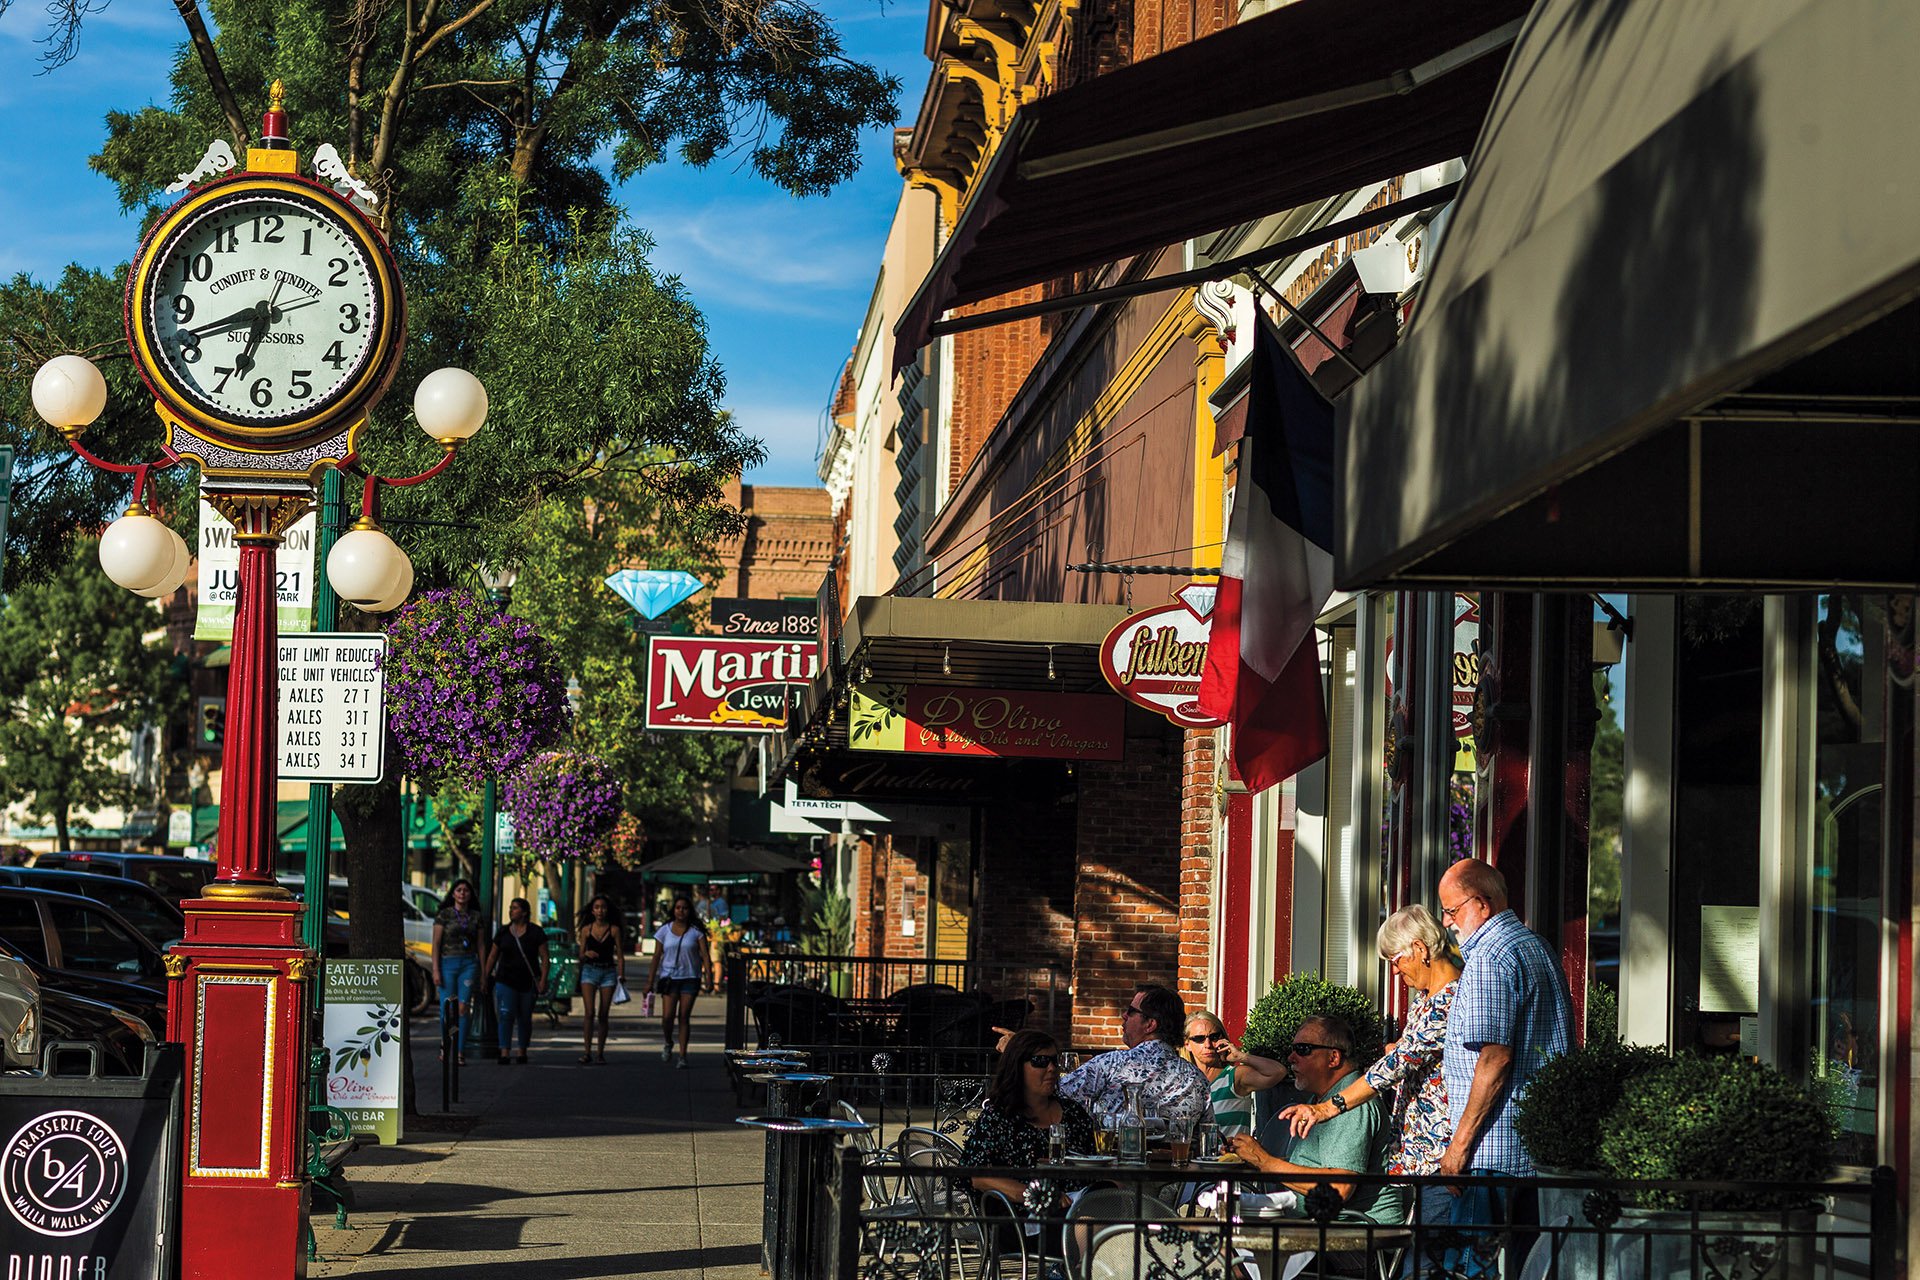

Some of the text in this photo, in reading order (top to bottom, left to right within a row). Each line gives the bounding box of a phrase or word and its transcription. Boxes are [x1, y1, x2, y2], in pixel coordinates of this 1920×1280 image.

[214, 226, 237, 253] 11
[251, 215, 285, 243] 12
[300, 228, 312, 255] 1
[181, 252, 213, 282] 10
[328, 258, 349, 287] 2
[210, 268, 323, 299] CUNDIFF & CUNDIFF
[175, 295, 195, 324] 9
[339, 303, 361, 333] 3
[181, 333, 202, 364] 8
[227, 330, 304, 345] SUCSSORS
[322, 340, 348, 370] 4
[211, 366, 235, 394] 7
[288, 370, 313, 400] 5
[250, 377, 273, 408] 6
[205, 527, 309, 550] SWE ION
[209, 570, 300, 591] JU 21
[209, 591, 217, 601] @
[219, 591, 237, 601] CRA
[725, 613, 817, 634] Since 1889
[279, 647, 298, 661] GHT
[304, 647, 329, 662] LIMIT
[1120, 627, 1209, 685] falken
[278, 668, 375, 682] GLE UNIT VEHICLES
[289, 688, 324, 703] AXLES
[344, 689, 358, 703] 27
[364, 689, 369, 703] T
[288, 710, 368, 725] AXLES 31 T
[287, 731, 367, 746] AXLES 33 T
[980, 730, 1008, 745] Oils
[1015, 733, 1041, 746] and
[1046, 733, 1109, 754] Vinegars
[286, 753, 367, 768] AXLES 34 T
[792, 800, 842, 809] TETRA TECH
[330, 976, 378, 986] SAVOUR
[363, 965, 399, 974] TASTE
[329, 1077, 373, 1093] Olivo
[363, 1111, 384, 1121] BAR
[13, 1118, 117, 1159] BRASSERIE FOUR
[14, 1195, 111, 1229] WALLA WALLA, WA
